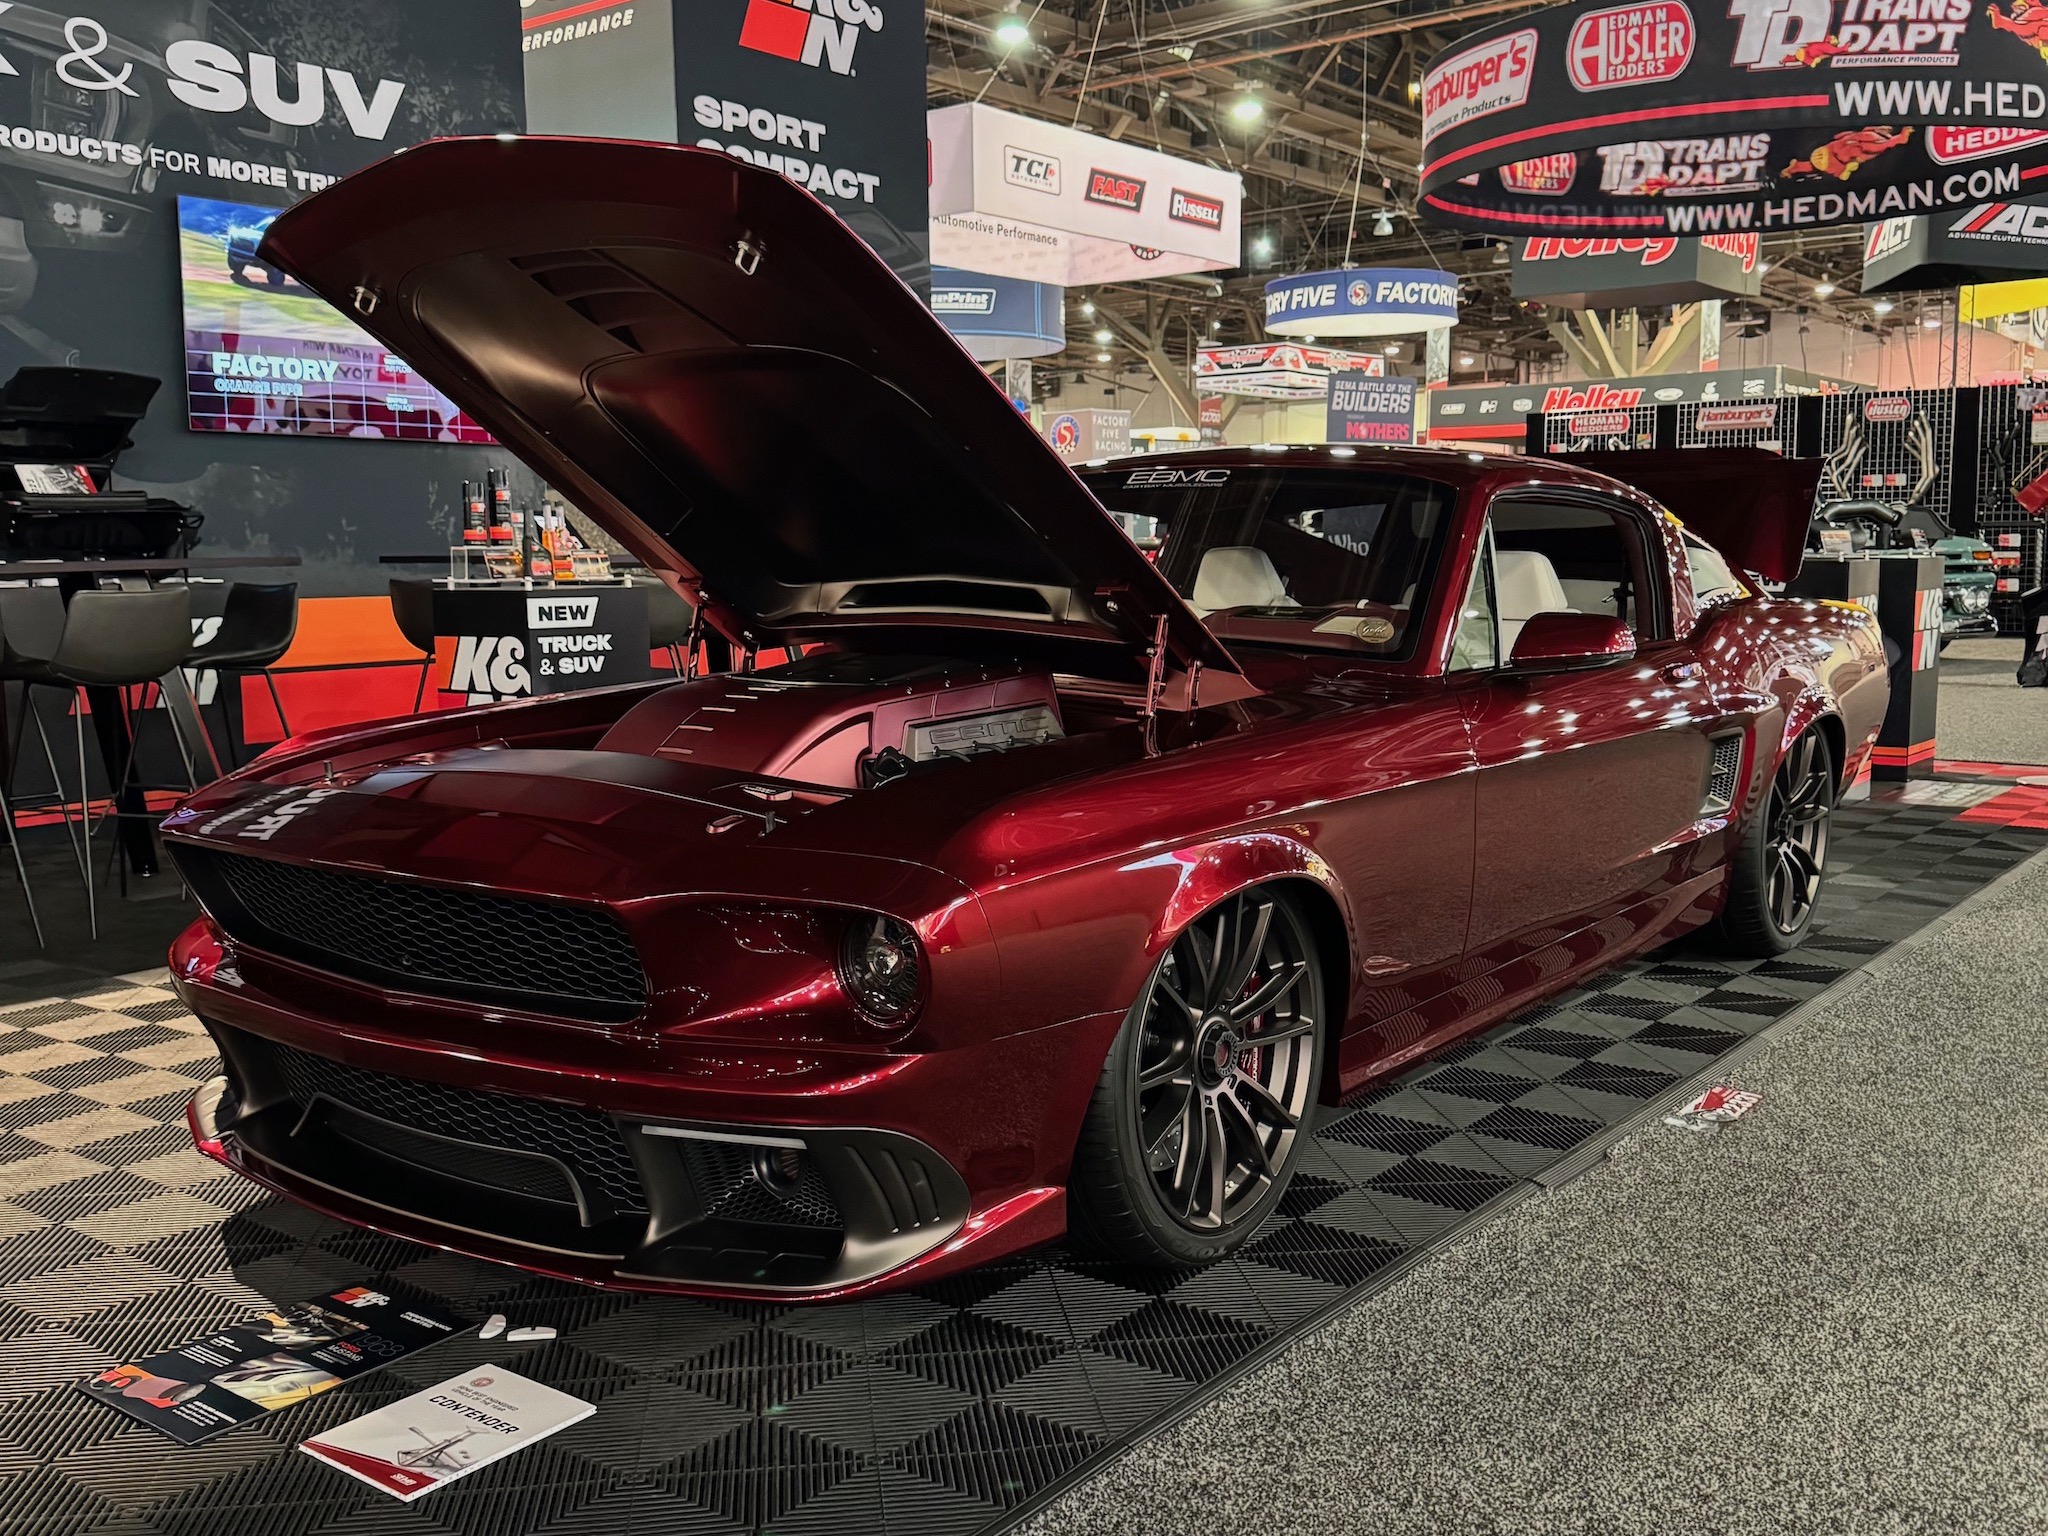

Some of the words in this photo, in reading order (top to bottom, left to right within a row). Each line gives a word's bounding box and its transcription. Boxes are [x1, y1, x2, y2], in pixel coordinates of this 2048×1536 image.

[1842, 0, 1971, 22] TRANS
[1840, 23, 1966, 51] DAPT
[1834, 55, 1906, 65] PERFORMANCE
[1908, 54, 1955, 64] PRODUCTS
[56, 16, 140, 98] &
[165, 39, 406, 141] SUV
[1426, 39, 1527, 118] amburger's
[1461, 95, 1512, 120] Products
[1835, 80, 2046, 118] WWW.HED
[693, 95, 827, 152] SPORT
[1662, 133, 1771, 165] TRANS
[149, 147, 201, 175] FOR
[206, 157, 288, 188] MORE
[1667, 160, 1765, 186] DAPT
[1092, 175, 1140, 203] FAST
[1667, 163, 2020, 233] WWW.HEDMAN.COM
[1171, 193, 1220, 223] RUSSELL
[996, 223, 1059, 246] Performance
[1947, 231, 1991, 241] ADVANCED
[1992, 235, 2022, 243] CLUTCH
[1291, 284, 1337, 311] FIVE
[1375, 281, 1454, 308] FACTORY
[212, 352, 340, 383] FACTORY
[214, 379, 271, 395] CHARGE
[271, 381, 304, 397] PIPE
[1335, 380, 1356, 390] SEMA
[1358, 381, 1384, 392] BATTLE
[1386, 383, 1396, 392] OF
[1398, 384, 1412, 393] THE
[1331, 390, 1411, 414] BUILDERS
[1540, 384, 1645, 414] Holley
[1092, 415, 1130, 427] FACTORY
[1574, 415, 1624, 426] HEDMAN
[1701, 406, 1774, 424] Hamburger's
[1102, 428, 1120, 439] FIVE
[1346, 421, 1410, 440] MOTHERS
[1095, 441, 1127, 451] RACING
[1126, 469, 1231, 485] EBMC
[538, 604, 590, 622] NEW
[537, 634, 613, 654] TRUCK
[539, 657, 556, 676] &
[558, 655, 606, 674] SUV
[327, 1344, 363, 1362] MUSTANG
[429, 1395, 520, 1435] CONTENDER
